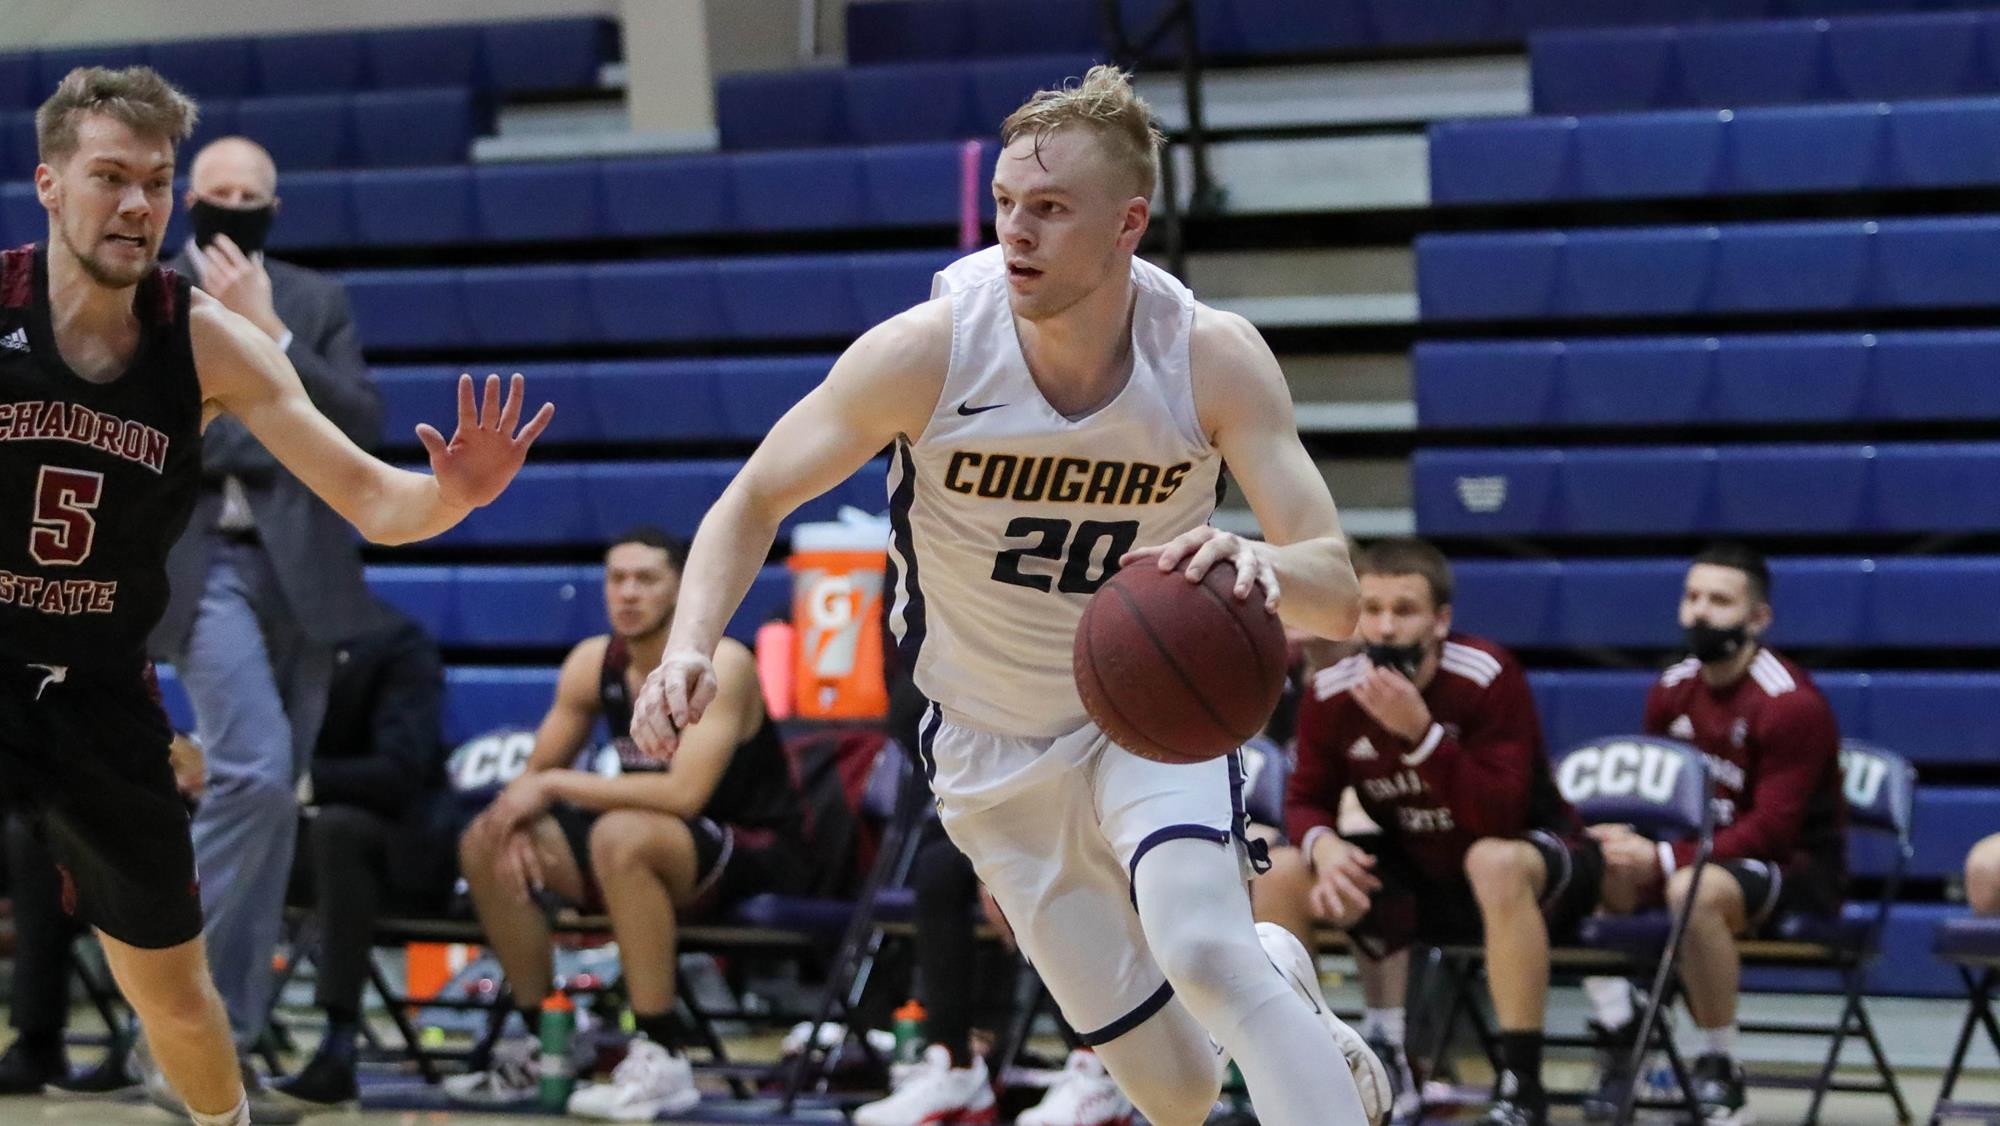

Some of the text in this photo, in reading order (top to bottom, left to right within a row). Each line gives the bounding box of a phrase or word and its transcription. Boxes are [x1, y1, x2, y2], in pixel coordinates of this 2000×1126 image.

[944, 451, 1192, 505] COUGARS
[29, 465, 104, 565] 5
[991, 517, 1140, 593] 20
[0, 570, 117, 615] STATE
[812, 575, 852, 629] G
[458, 733, 536, 789] CC
[1556, 742, 1684, 804] CCU
